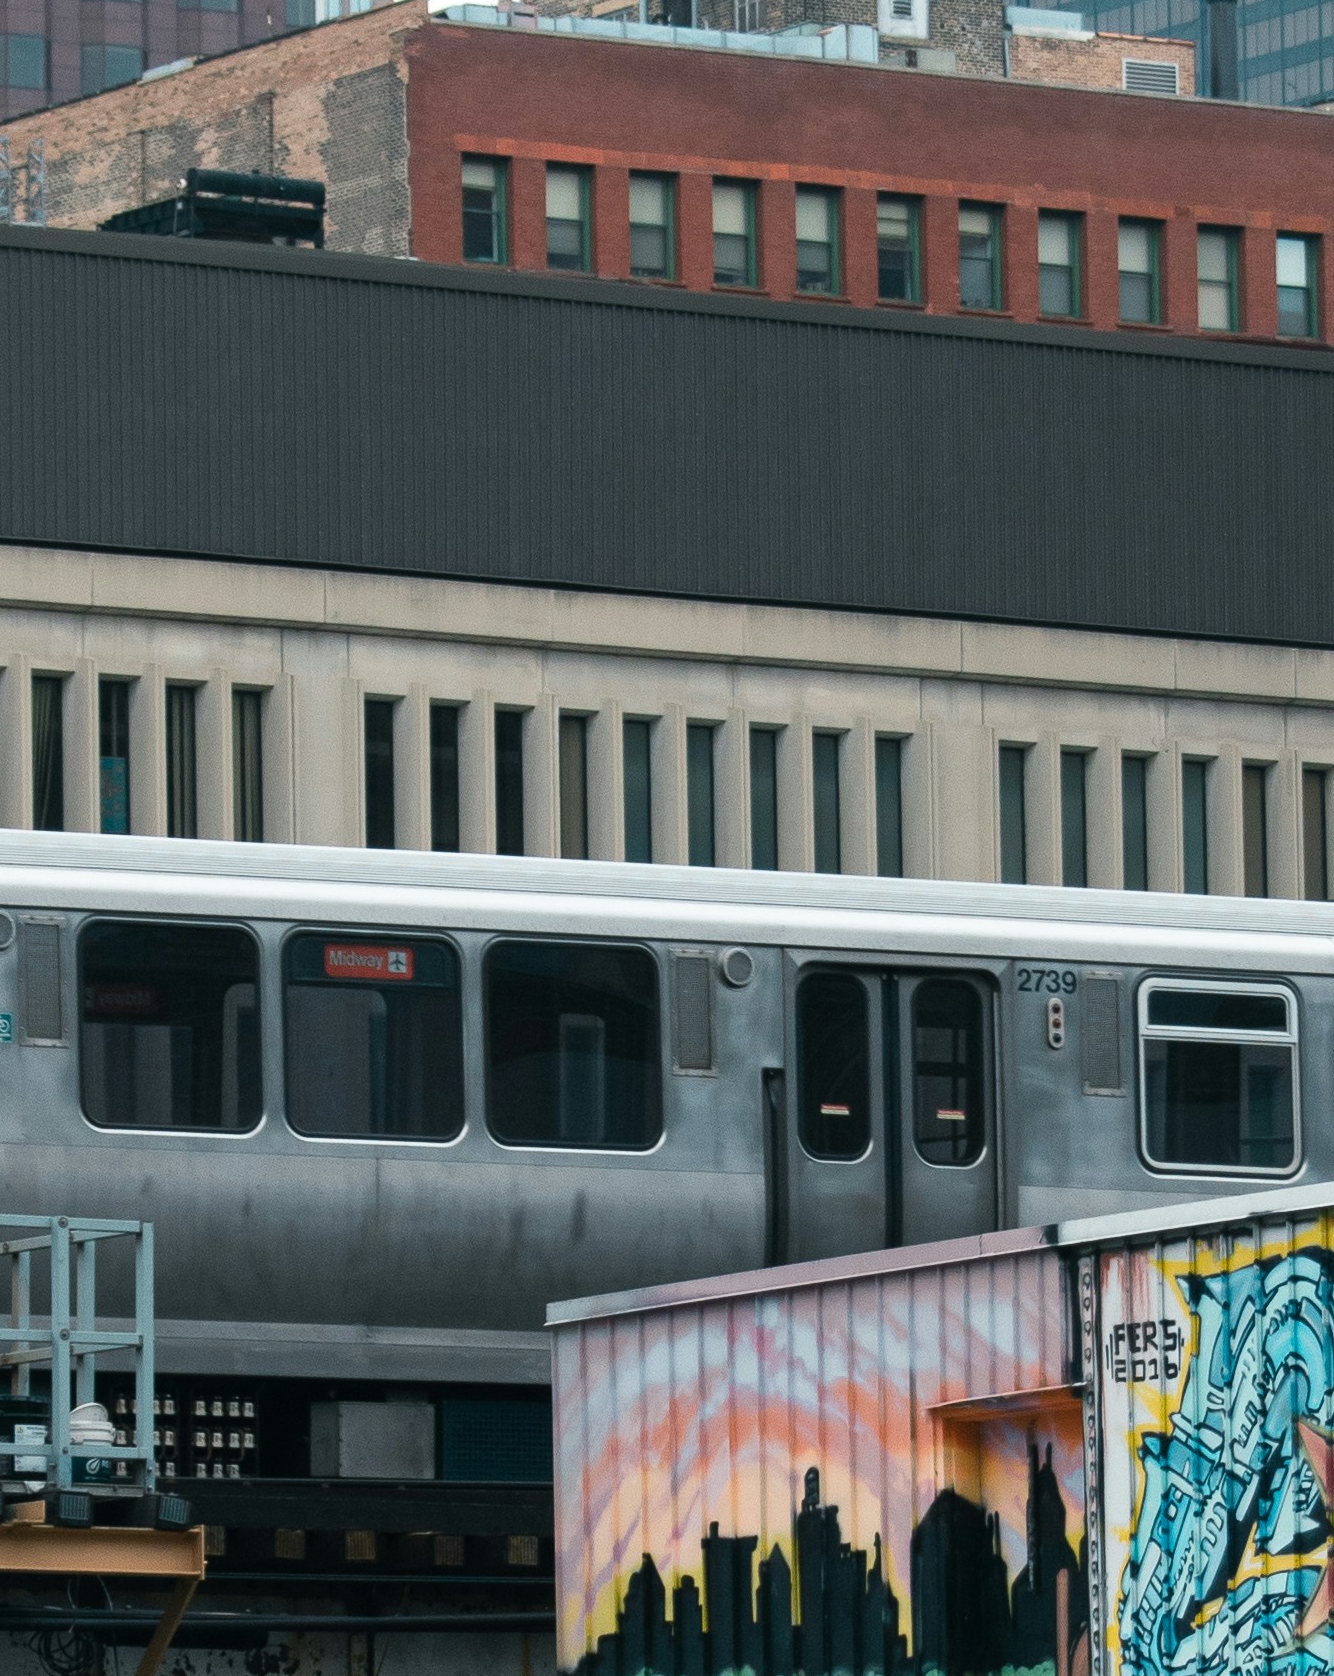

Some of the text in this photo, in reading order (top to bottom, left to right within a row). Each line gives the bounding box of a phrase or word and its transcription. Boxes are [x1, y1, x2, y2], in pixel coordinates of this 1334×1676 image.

[329, 949, 384, 970] Midway
[1017, 968, 1077, 994] 2739
[1113, 1319, 1178, 1356] FERS
[1114, 1355, 1179, 1383] 2016
